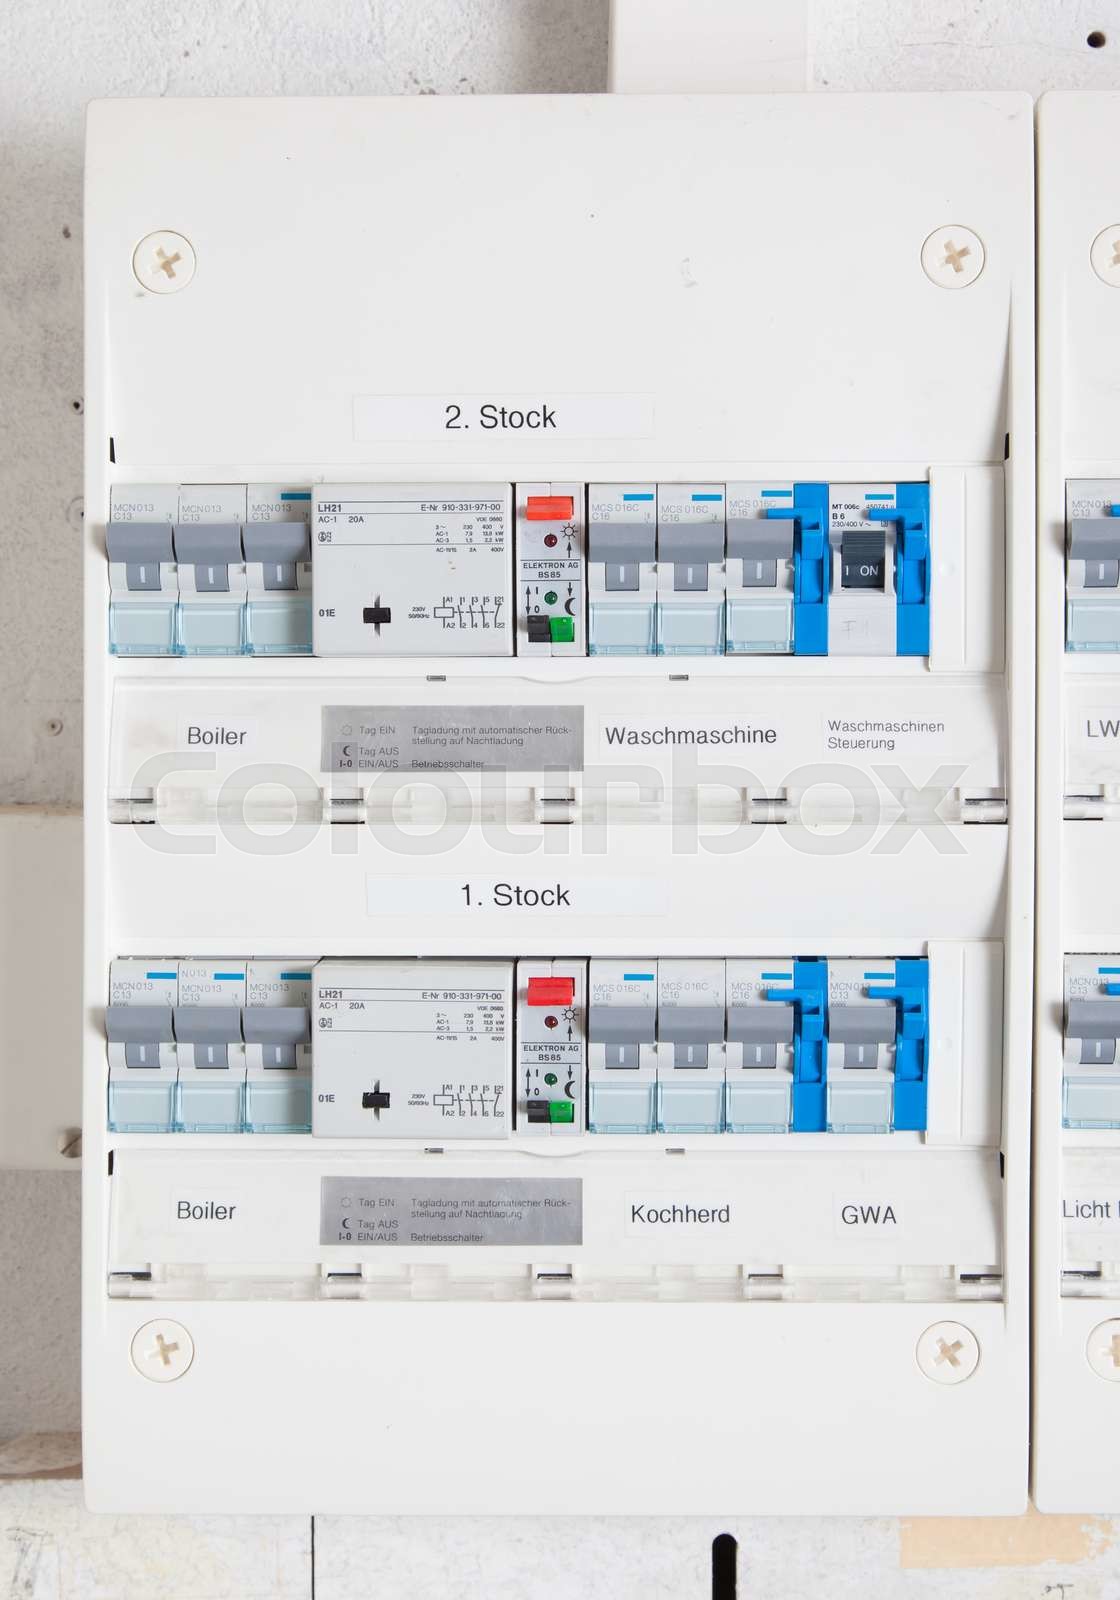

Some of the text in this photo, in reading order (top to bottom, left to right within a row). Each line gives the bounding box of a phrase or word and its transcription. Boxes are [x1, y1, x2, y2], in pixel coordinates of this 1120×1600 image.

[445, 404, 557, 429] 2. Stock
[318, 504, 342, 512] LH21
[421, 504, 501, 512] E-Nr 910-331-971-00
[591, 503, 639, 512] MCS 016C
[729, 500, 750, 508] MCS
[661, 505, 708, 514] MCS 016C
[113, 513, 132, 521] C13
[182, 514, 200, 522] C13
[252, 513, 270, 521] C13
[591, 513, 610, 521] C16
[661, 514, 680, 522] C16
[860, 565, 879, 577] ON
[319, 609, 336, 617] 01E
[827, 719, 945, 732] Waschmaschinen
[1087, 720, 1120, 737] LW
[188, 726, 247, 745] Boiler
[359, 726, 396, 736] Tag EIN
[412, 726, 460, 736] Tagladung
[462, 726, 476, 735] mit
[479, 726, 542, 735] automatischer
[605, 726, 777, 745] Waschmaschine
[412, 737, 524, 747] stellung auf Nachtladung
[827, 736, 896, 751] Steuerung
[359, 747, 399, 757] Tag AUS
[358, 759, 399, 768] EIN/AUS
[412, 759, 485, 768] Betriebsschalter
[461, 883, 571, 906] 1. Stock
[593, 984, 640, 993] MCS 016C
[661, 982, 709, 991] MCS 016C
[731, 983, 753, 991] MCS
[113, 991, 132, 999] C13
[182, 993, 200, 1001] C13
[250, 992, 268, 1000] C13
[319, 991, 343, 999] LH21
[422, 992, 502, 1000] E-Nr 910-331-971-00
[593, 993, 612, 1001] C16
[661, 991, 680, 999] C16
[319, 1002, 365, 1010] AC-1 20A
[318, 1095, 335, 1103] 01E
[359, 1198, 394, 1209] Tag EIN
[411, 1199, 459, 1209] Tagladung
[461, 1199, 476, 1207] mit
[177, 1201, 236, 1220] Boiler
[1063, 1200, 1111, 1218] Licht
[411, 1210, 446, 1220] stellung
[449, 1210, 463, 1218] auf
[631, 1204, 730, 1224] Kochherd
[841, 1206, 897, 1225] GWA
[358, 1220, 399, 1230] Tag AUS
[357, 1233, 398, 1241] EIN/AUS
[411, 1233, 484, 1242] Betriebsschalter
